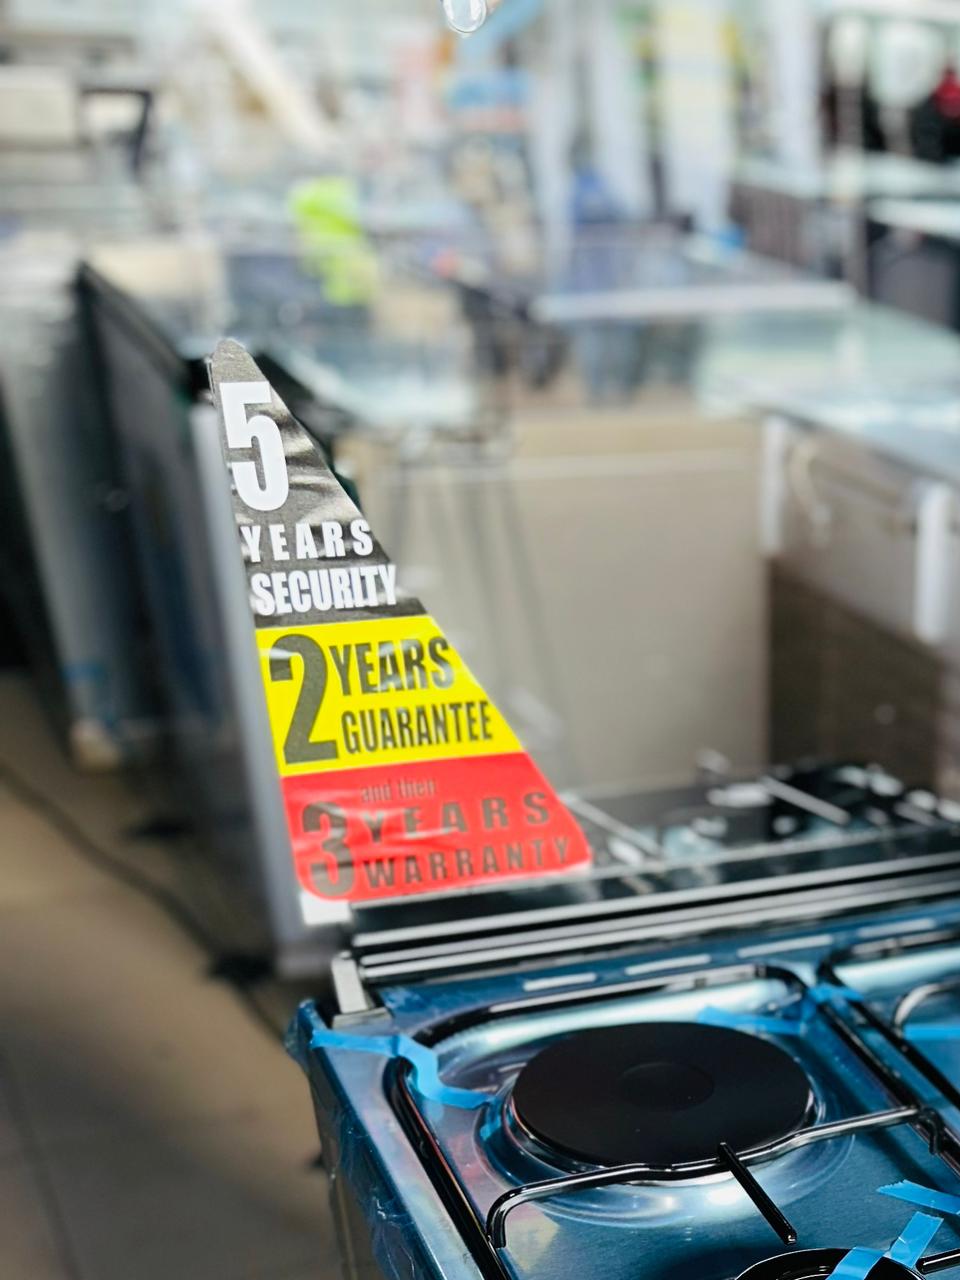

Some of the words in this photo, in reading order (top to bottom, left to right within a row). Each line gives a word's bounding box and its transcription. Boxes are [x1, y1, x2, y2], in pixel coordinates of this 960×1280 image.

[219, 381, 289, 511] 5
[241, 519, 374, 562] YEARS
[250, 563, 397, 616] SECURITY
[268, 633, 339, 764] 2
[328, 636, 455, 696] YEARS
[341, 700, 494, 754] GUARANTEE
[301, 801, 355, 896] 3
[362, 792, 550, 843] YEARS
[363, 837, 569, 889] WARRANTY
